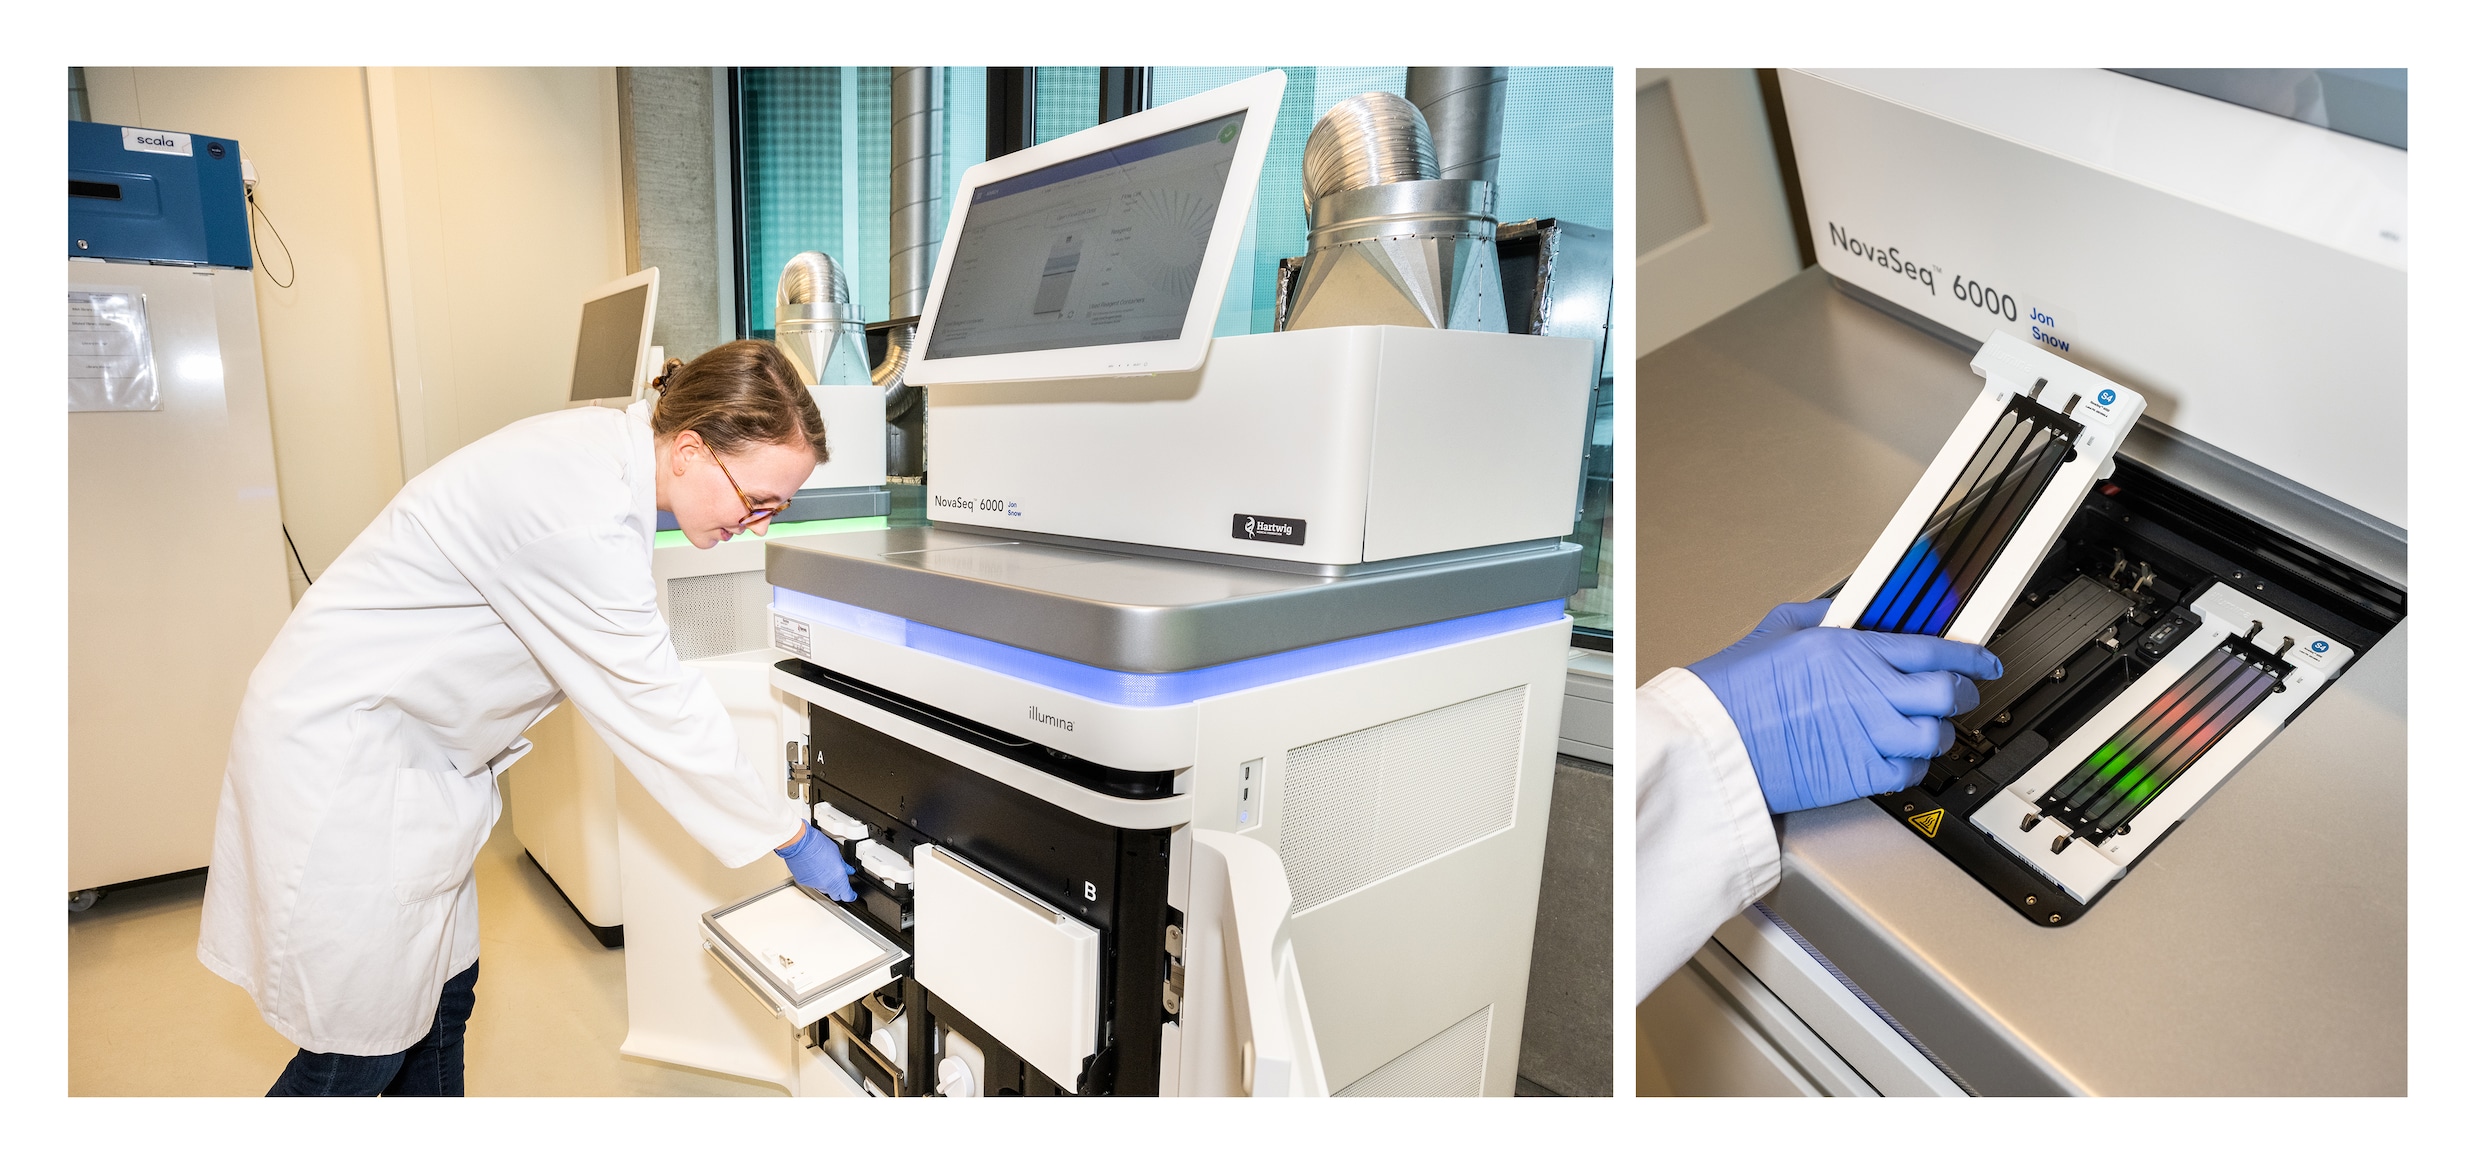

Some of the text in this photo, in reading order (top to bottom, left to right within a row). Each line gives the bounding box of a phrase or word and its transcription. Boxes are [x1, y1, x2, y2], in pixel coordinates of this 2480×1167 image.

[137, 135, 174, 147] scala
[1953, 275, 2017, 322] 6000
[2029, 307, 2055, 328] Jon
[2031, 325, 2070, 352] Snow
[2101, 391, 2113, 402] S4
[980, 499, 1004, 512] 6000
[1257, 521, 1292, 536] Hartwig
[2314, 642, 2327, 651] S4
[1029, 705, 1074, 732] illumina
[817, 750, 825, 765] A
[1084, 880, 1097, 902] B
